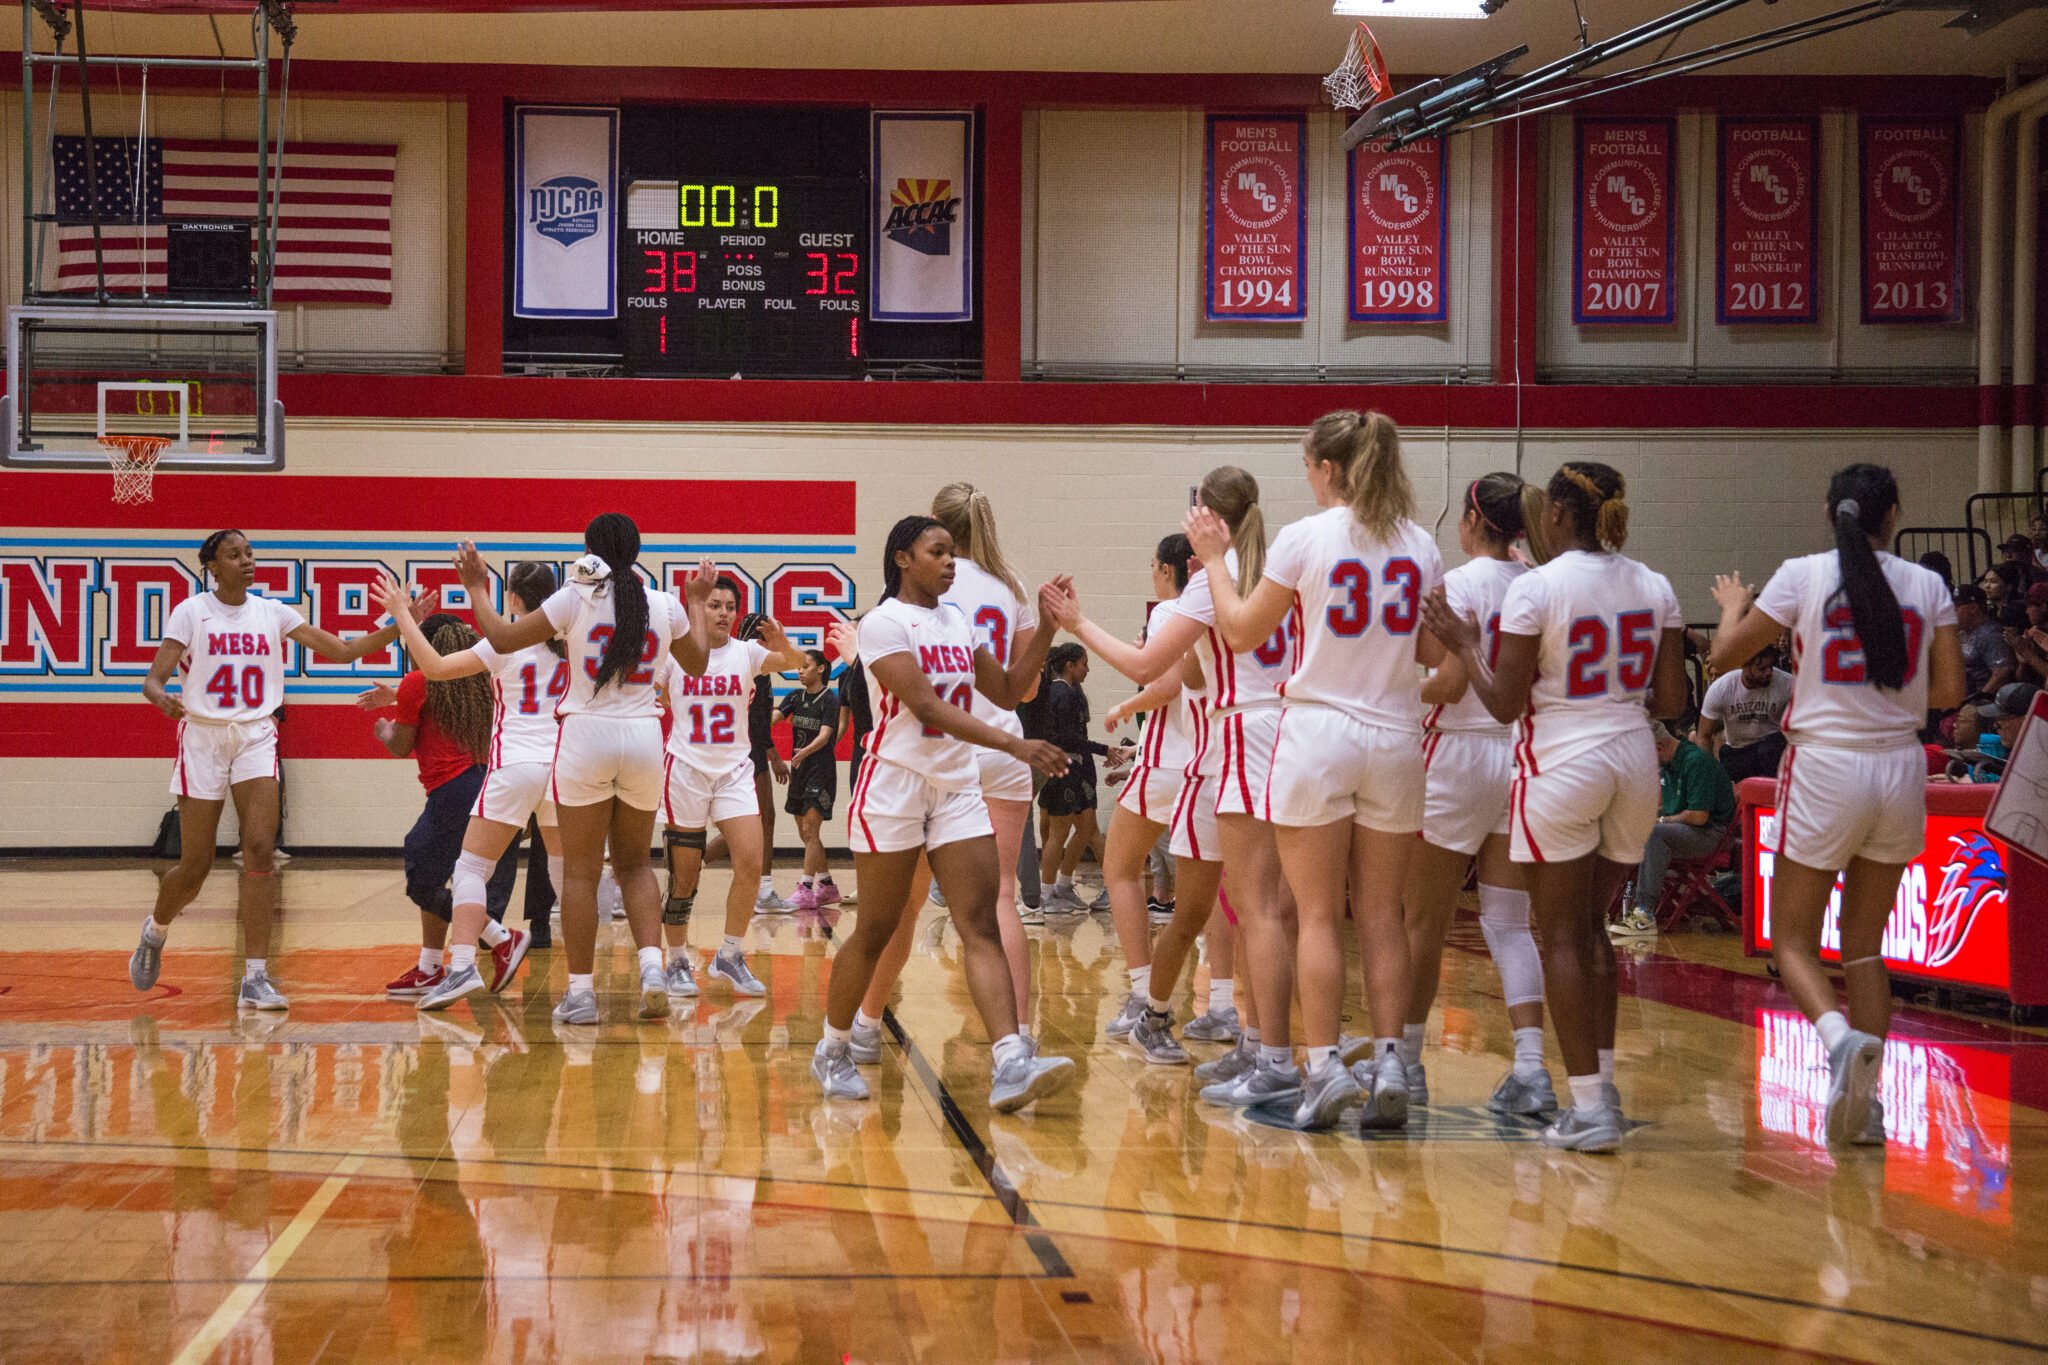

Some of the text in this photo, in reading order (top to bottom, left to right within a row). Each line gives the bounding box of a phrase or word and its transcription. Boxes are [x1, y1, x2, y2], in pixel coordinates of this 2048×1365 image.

[1236, 128, 1277, 138] MEN'S
[1605, 130, 1647, 141] MEN'S
[1221, 141, 1292, 152] FOOTBALL
[1363, 142, 1434, 153] FOBALL
[1590, 144, 1662, 155] FOOTBALL
[1221, 156, 1292, 204] MESA COMMUNITY COLLEGE
[1362, 158, 1434, 206] MESA COMMUNITY COLLEGE
[1589, 159, 1661, 207] MESA COMMUNITY COLLEGE
[1239, 173, 1276, 212] MCC
[1380, 174, 1418, 214] MCC
[530, 189, 603, 223] NJCAA
[882, 197, 961, 233] ACCAC
[1226, 207, 1288, 229] THUNDERBIRDS
[1368, 209, 1430, 230] THUNDERBIRDS
[1595, 211, 1657, 232] THUNDERBIRDS
[637, 231, 685, 245] HOME
[720, 235, 766, 246] PERIOD
[799, 233, 854, 247] GUEST
[1234, 233, 1278, 243] VALLEY
[1376, 234, 1419, 244] VALLEY
[1603, 236, 1646, 246] VALLEY
[1221, 244, 1291, 254] OF THE SUN
[1362, 246, 1433, 255] OF THE SUN
[1589, 248, 1660, 257] OF THE SUN
[1239, 255, 1274, 265] BOWL
[1381, 256, 1416, 266] BOWL
[1607, 258, 1643, 268] BOWL
[644, 251, 696, 292] 38
[727, 265, 762, 276] POSS
[806, 253, 858, 294] 32
[1220, 266, 1293, 276] CHAMPIONS
[1365, 267, 1431, 277] RUNNER-UP
[1588, 269, 1661, 279] CHAMPIONS
[722, 280, 765, 291] BONUS
[1220, 279, 1292, 307] 1994
[1362, 280, 1433, 308] 1998
[1587, 282, 1660, 310] 2007
[1731, 282, 1804, 310] 2012
[1873, 281, 1947, 309] 2013
[627, 297, 668, 308] FOULS
[698, 299, 746, 310] PLAYER
[764, 299, 797, 310] FOUL
[820, 300, 860, 311] FOULS
[660, 315, 666, 354] 1
[851, 317, 857, 356] 1
[1326, 556, 1422, 638] 33
[208, 633, 270, 656] MESA
[1566, 609, 1655, 699] 25
[206, 663, 265, 709] 40
[519, 658, 570, 715] 14
[683, 674, 742, 696] MESA
[1730, 701, 1776, 714] ARIZONA
[688, 703, 735, 745] 12
